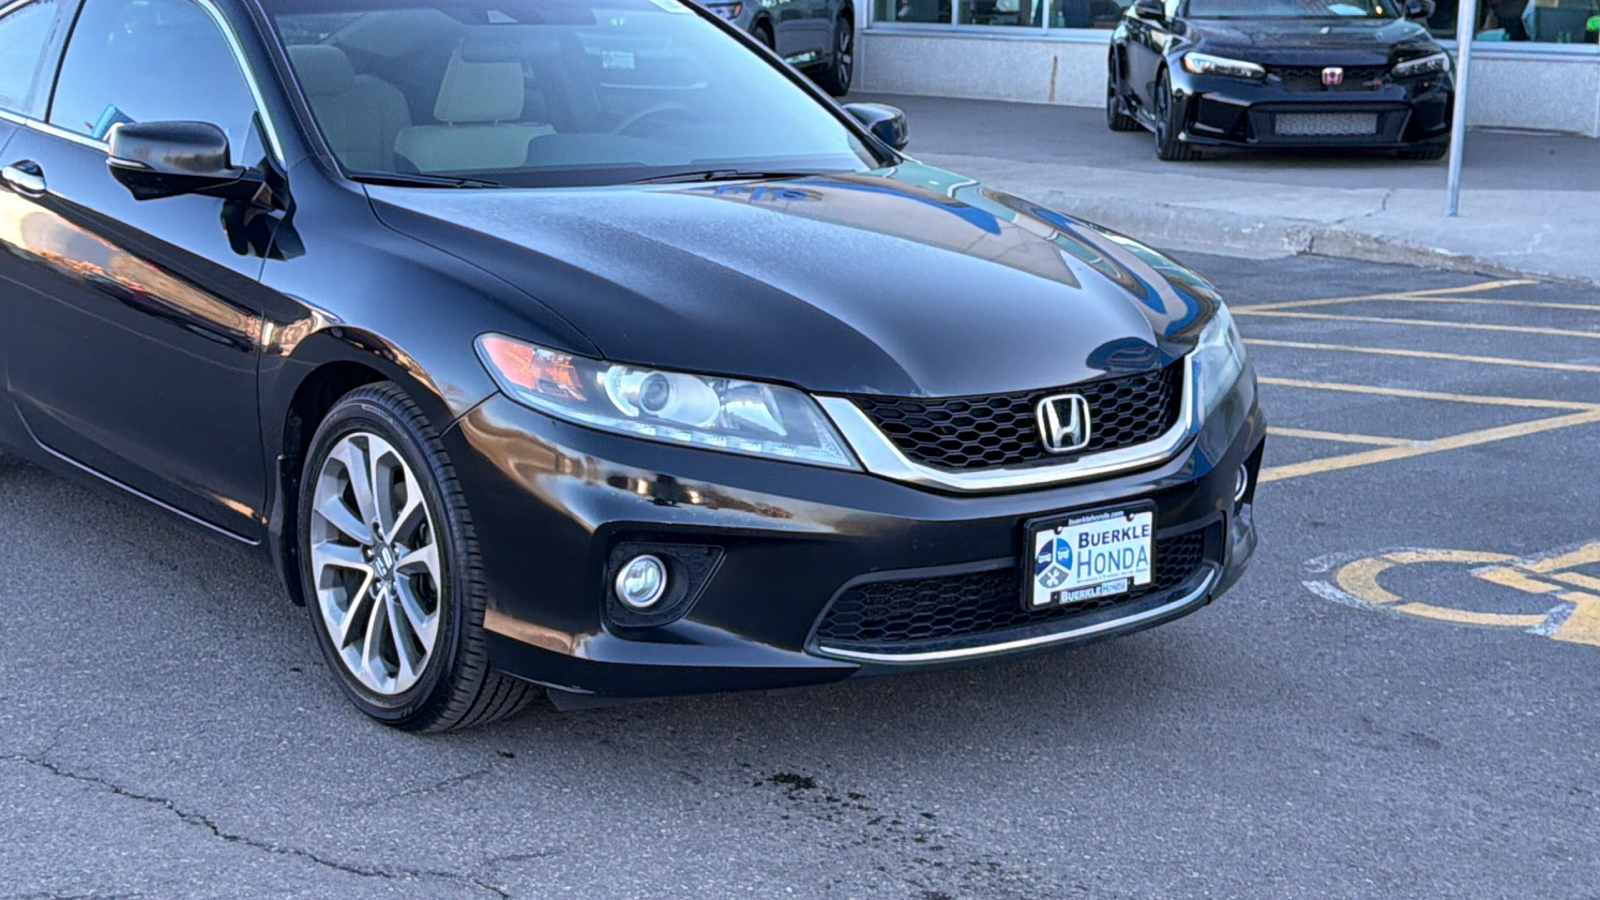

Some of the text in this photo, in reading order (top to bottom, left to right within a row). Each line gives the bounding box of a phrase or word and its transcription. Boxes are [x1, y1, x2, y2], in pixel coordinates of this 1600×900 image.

[1078, 524, 1150, 549] BUERKLE
[1077, 545, 1148, 578] HONDA
[1061, 586, 1102, 602] BUERKLE
